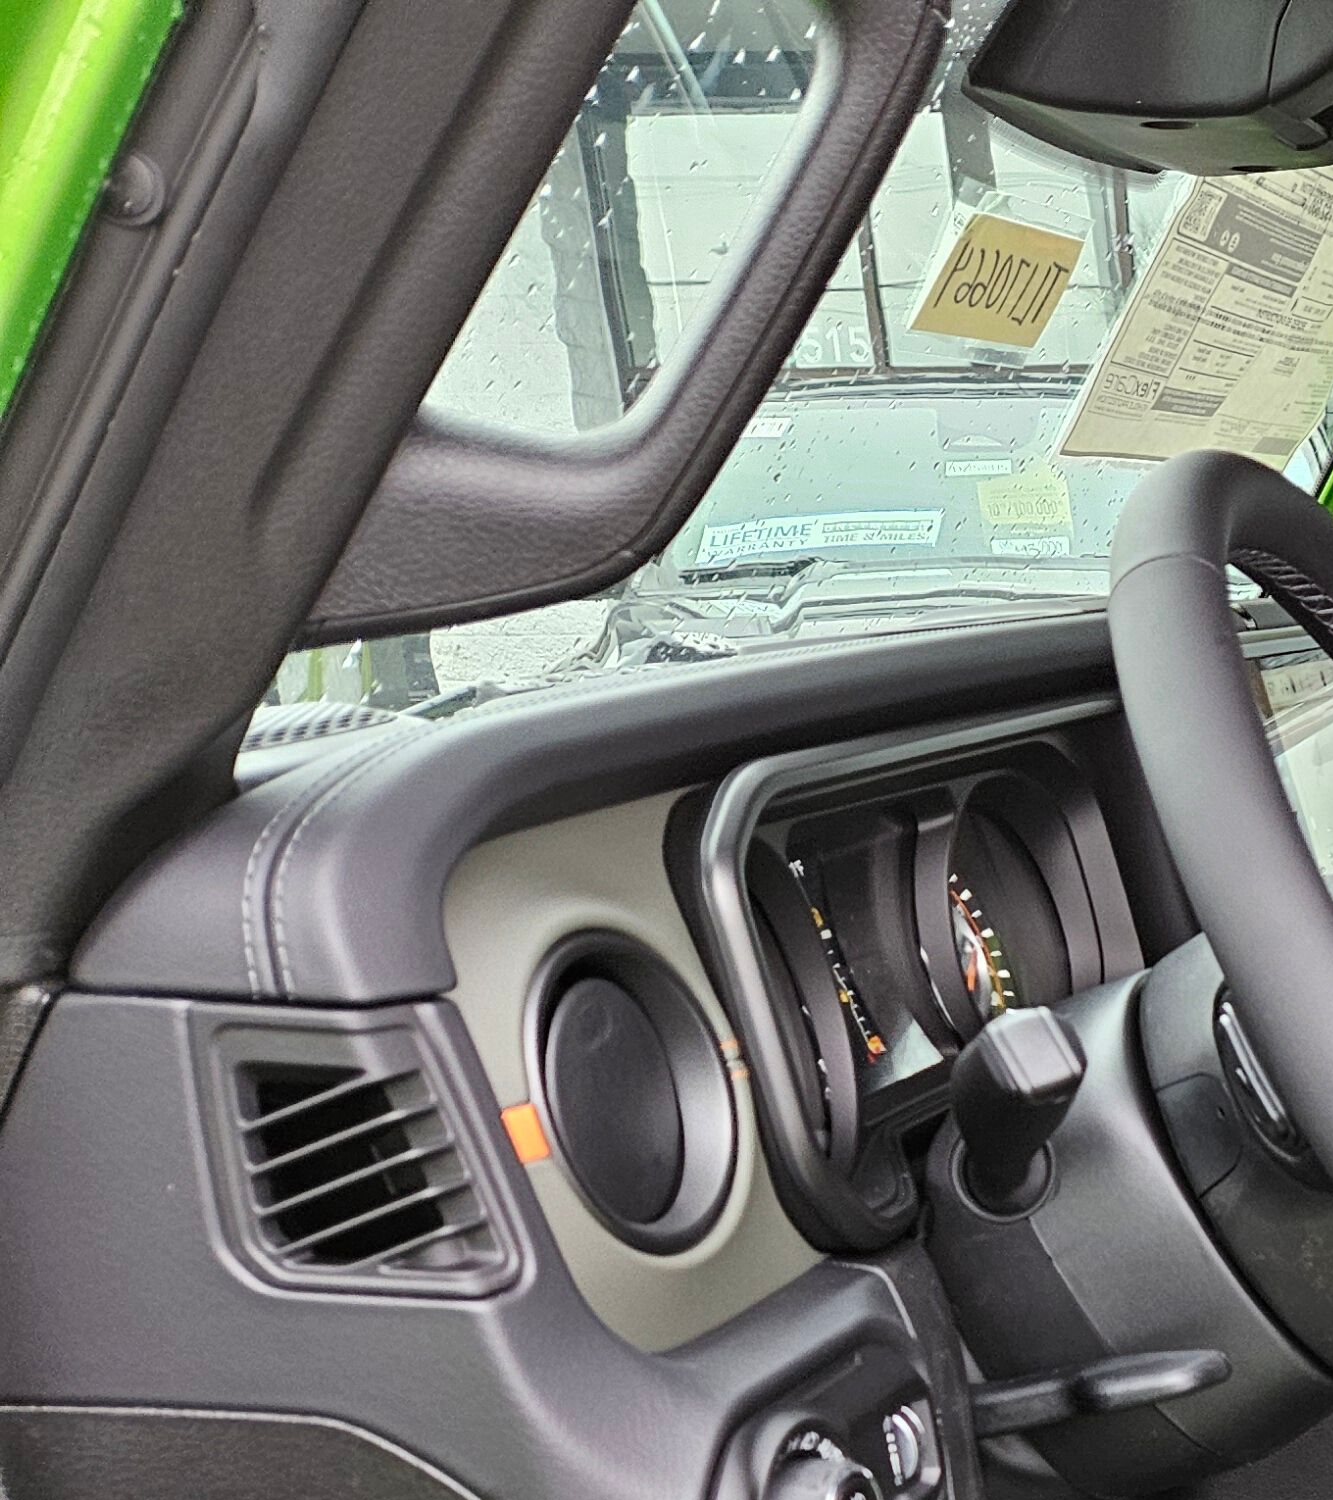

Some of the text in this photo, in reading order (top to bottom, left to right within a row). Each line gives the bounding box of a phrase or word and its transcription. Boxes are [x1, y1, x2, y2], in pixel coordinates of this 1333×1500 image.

[709, 523, 813, 548] LIFETIME
[823, 532, 859, 543] TIME
[880, 531, 927, 542] MILES
[706, 538, 809, 558] WARRANTY
